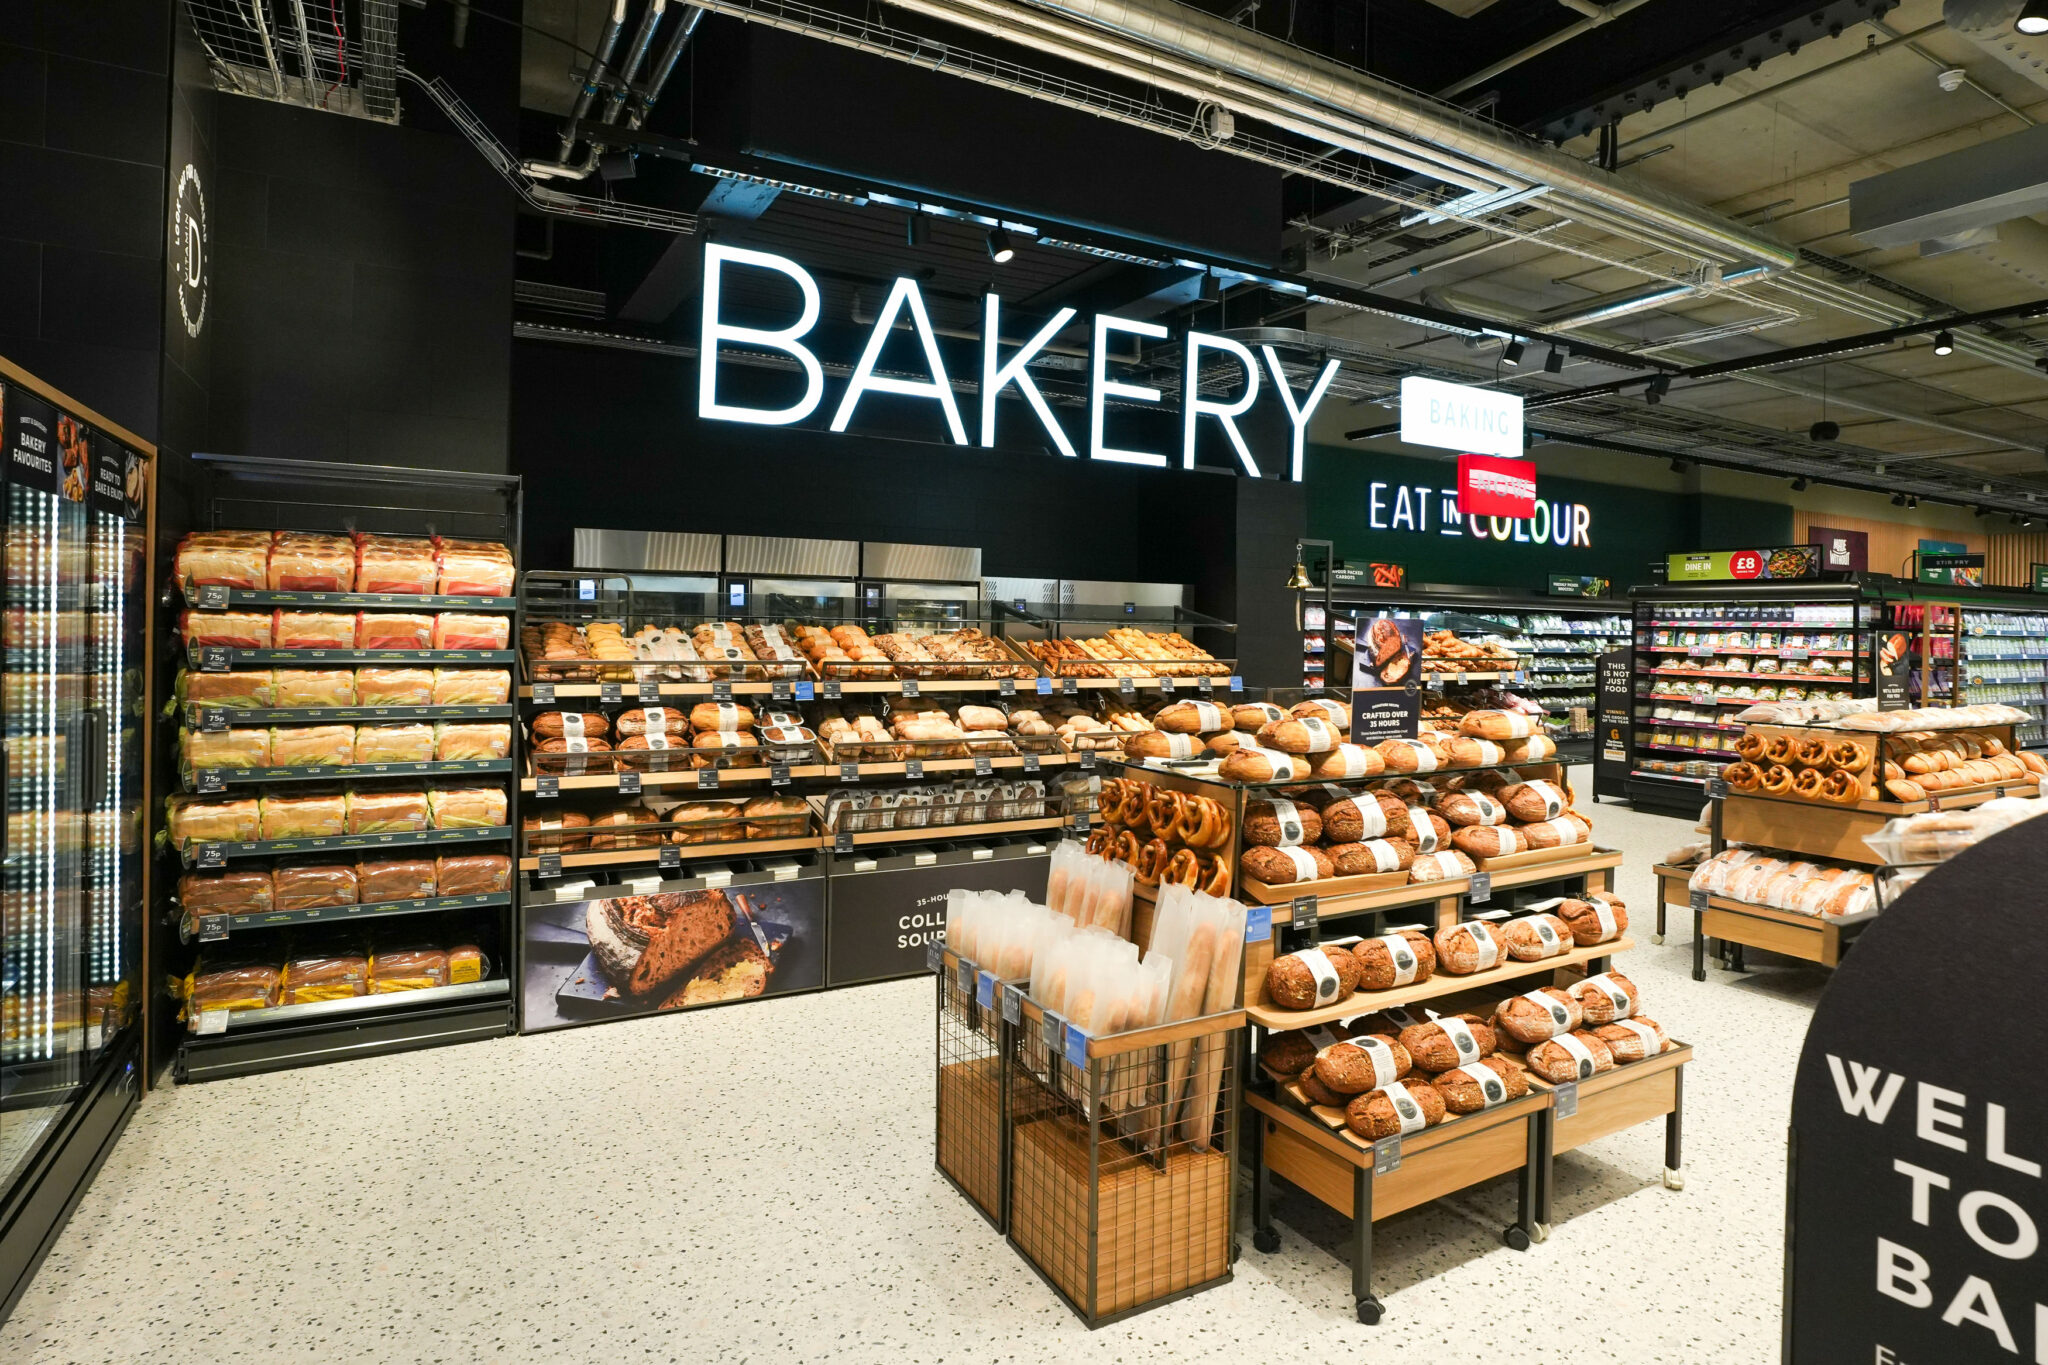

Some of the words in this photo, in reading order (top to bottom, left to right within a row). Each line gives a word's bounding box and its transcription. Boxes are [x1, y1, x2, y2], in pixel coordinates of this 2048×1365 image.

[188, 216, 202, 288] D
[699, 242, 1341, 483] BAKERY
[1429, 397, 1509, 436] BAKING
[20, 432, 47, 454] BAKERY
[13, 448, 53, 474] FAVOURITES
[100, 467, 114, 483] READY
[114, 474, 121, 486] TO
[94, 480, 107, 495] BAKE
[110, 486, 124, 502] ENJOY
[1477, 473, 1529, 500] NOW
[1370, 482, 1432, 532] EAT
[1442, 498, 1462, 525] IN
[1685, 562, 1702, 571] DINE
[1703, 562, 1712, 570] IN
[1737, 557, 1755, 570] £8
[207, 592, 222, 600] 75p
[209, 654, 225, 662] 75p
[1607, 662, 1626, 670] THIS
[1605, 685, 1628, 693] FOOD
[208, 715, 224, 723] 75p
[1362, 711, 1390, 719] CRAFTED
[1391, 710, 1409, 718] OVER
[1370, 720, 1377, 728] 35
[1378, 719, 1400, 727] HOURS
[1610, 728, 1620, 740] G
[204, 775, 221, 783] 75p
[205, 850, 221, 858] 75p
[916, 893, 949, 907] 35-HOU
[205, 924, 221, 932] 75p
[899, 912, 945, 930] COLL
[1825, 1053, 2042, 1179] WEL
[1893, 1158, 2040, 1261] TO
[1876, 1236, 2048, 1365] BA
